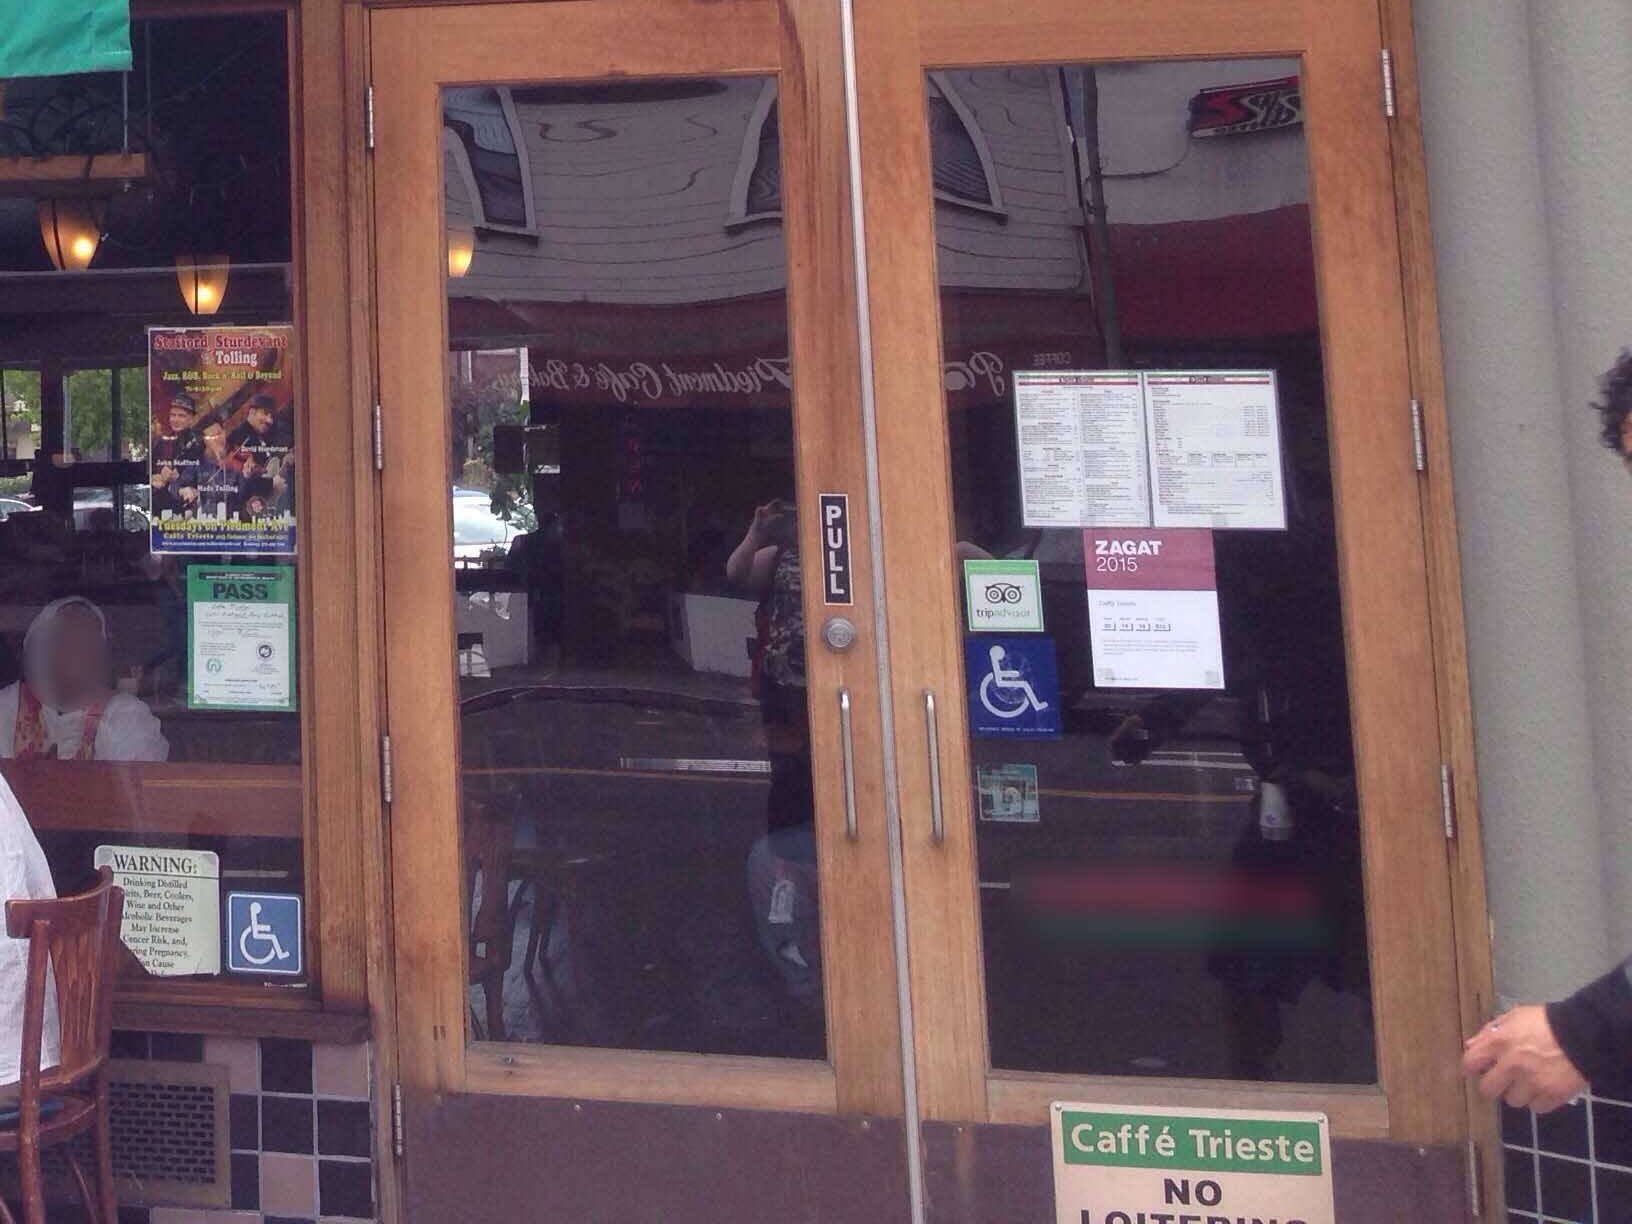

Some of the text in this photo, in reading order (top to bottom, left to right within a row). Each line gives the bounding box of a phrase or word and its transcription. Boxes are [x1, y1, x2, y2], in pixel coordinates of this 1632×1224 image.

[215, 334, 288, 349] Sturdevant
[215, 350, 258, 367] Tolling
[158, 519, 203, 533] Tuesdays
[205, 521, 218, 532] on
[824, 504, 845, 597] PULL
[1095, 539, 1163, 556] ZAGAT
[1096, 556, 1139, 573] 2015
[212, 583, 269, 600] PASS
[976, 607, 1031, 620] tripadvisor
[113, 853, 198, 874] WARNING:
[123, 877, 188, 889] Drinking Distilled
[124, 888, 194, 903] irits, Beer, Coolers,
[126, 900, 184, 911] Wine and Other
[155, 913, 193, 924] Beverages
[131, 923, 179, 933] May Increase
[129, 946, 148, 956] ring
[152, 959, 175, 968] Cause
[1070, 1123, 1315, 1163] Caffé Trieste
[1163, 1178, 1223, 1206] NO
